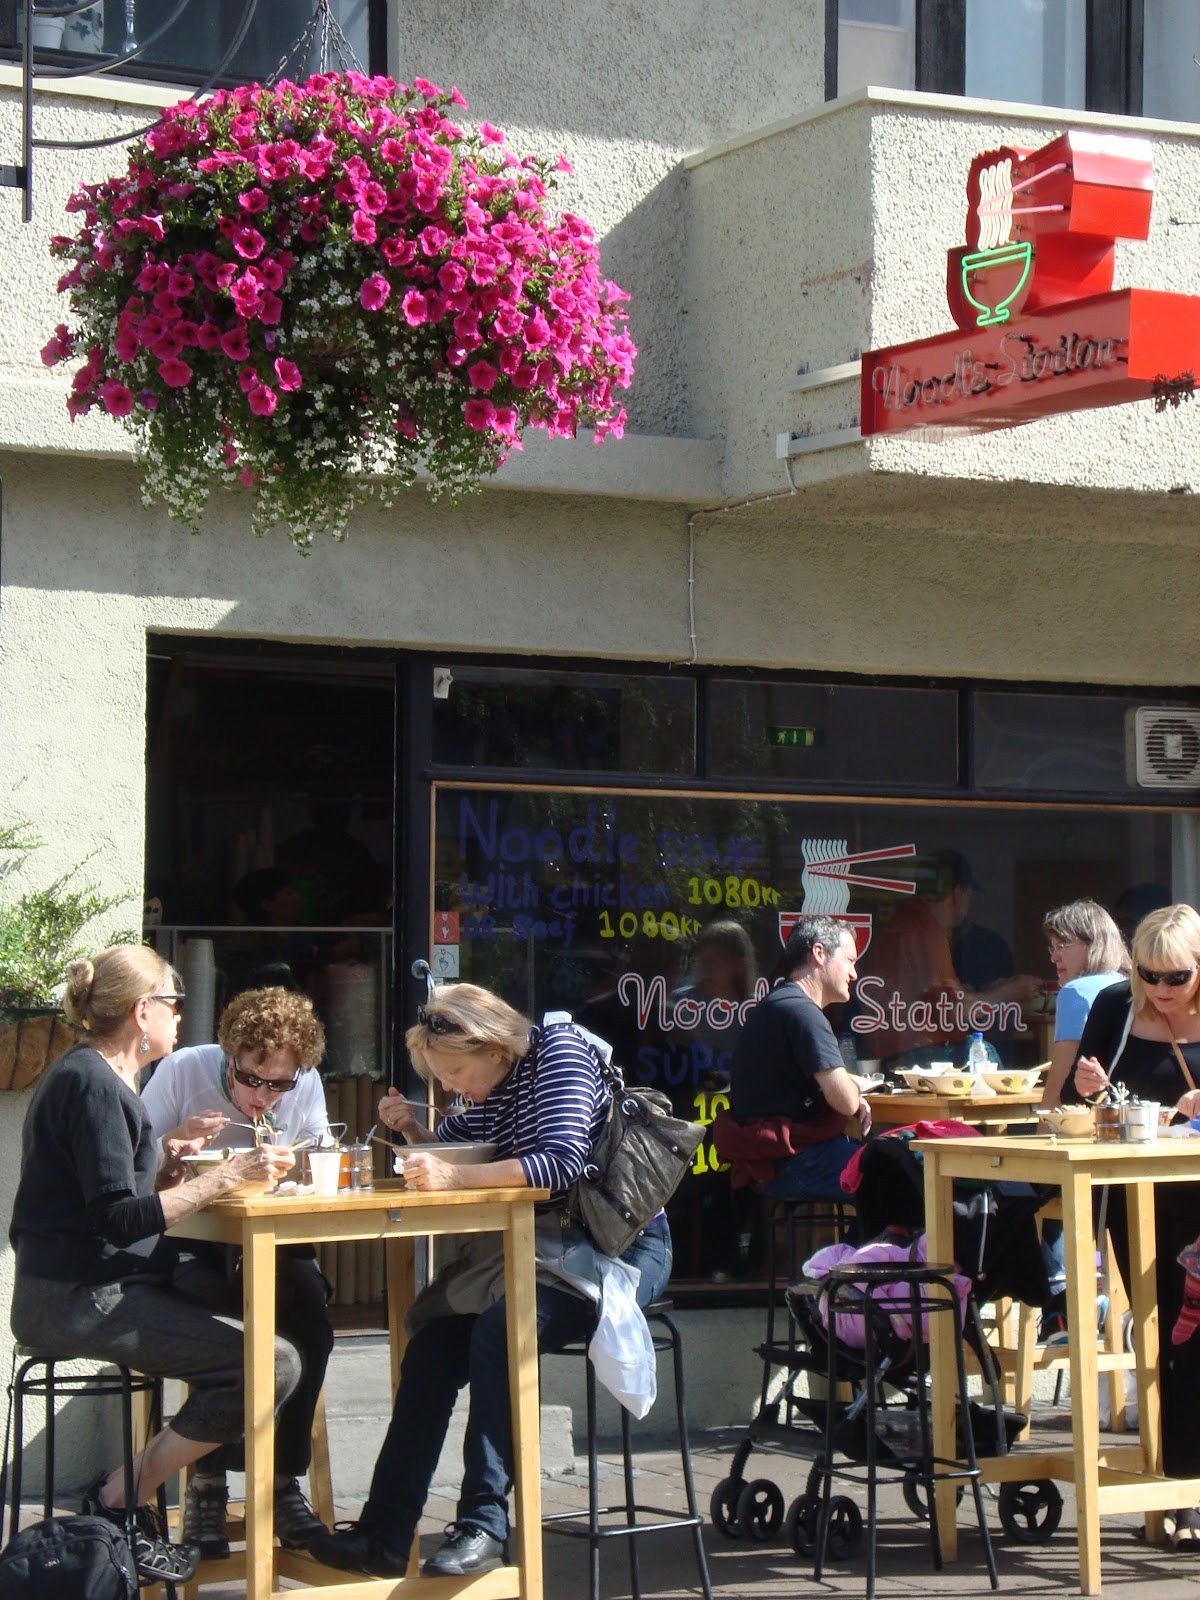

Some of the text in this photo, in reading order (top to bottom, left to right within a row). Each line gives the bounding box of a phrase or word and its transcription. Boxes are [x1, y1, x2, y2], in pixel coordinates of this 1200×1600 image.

[872, 333, 1118, 409] Noodle Station
[459, 796, 759, 876] Noodle soup
[550, 871, 671, 909] chicken
[512, 911, 578, 946] Beef
[617, 972, 1028, 1033] Nood Station
[692, 1092, 731, 1126] 10
[692, 1142, 731, 1175] 10
